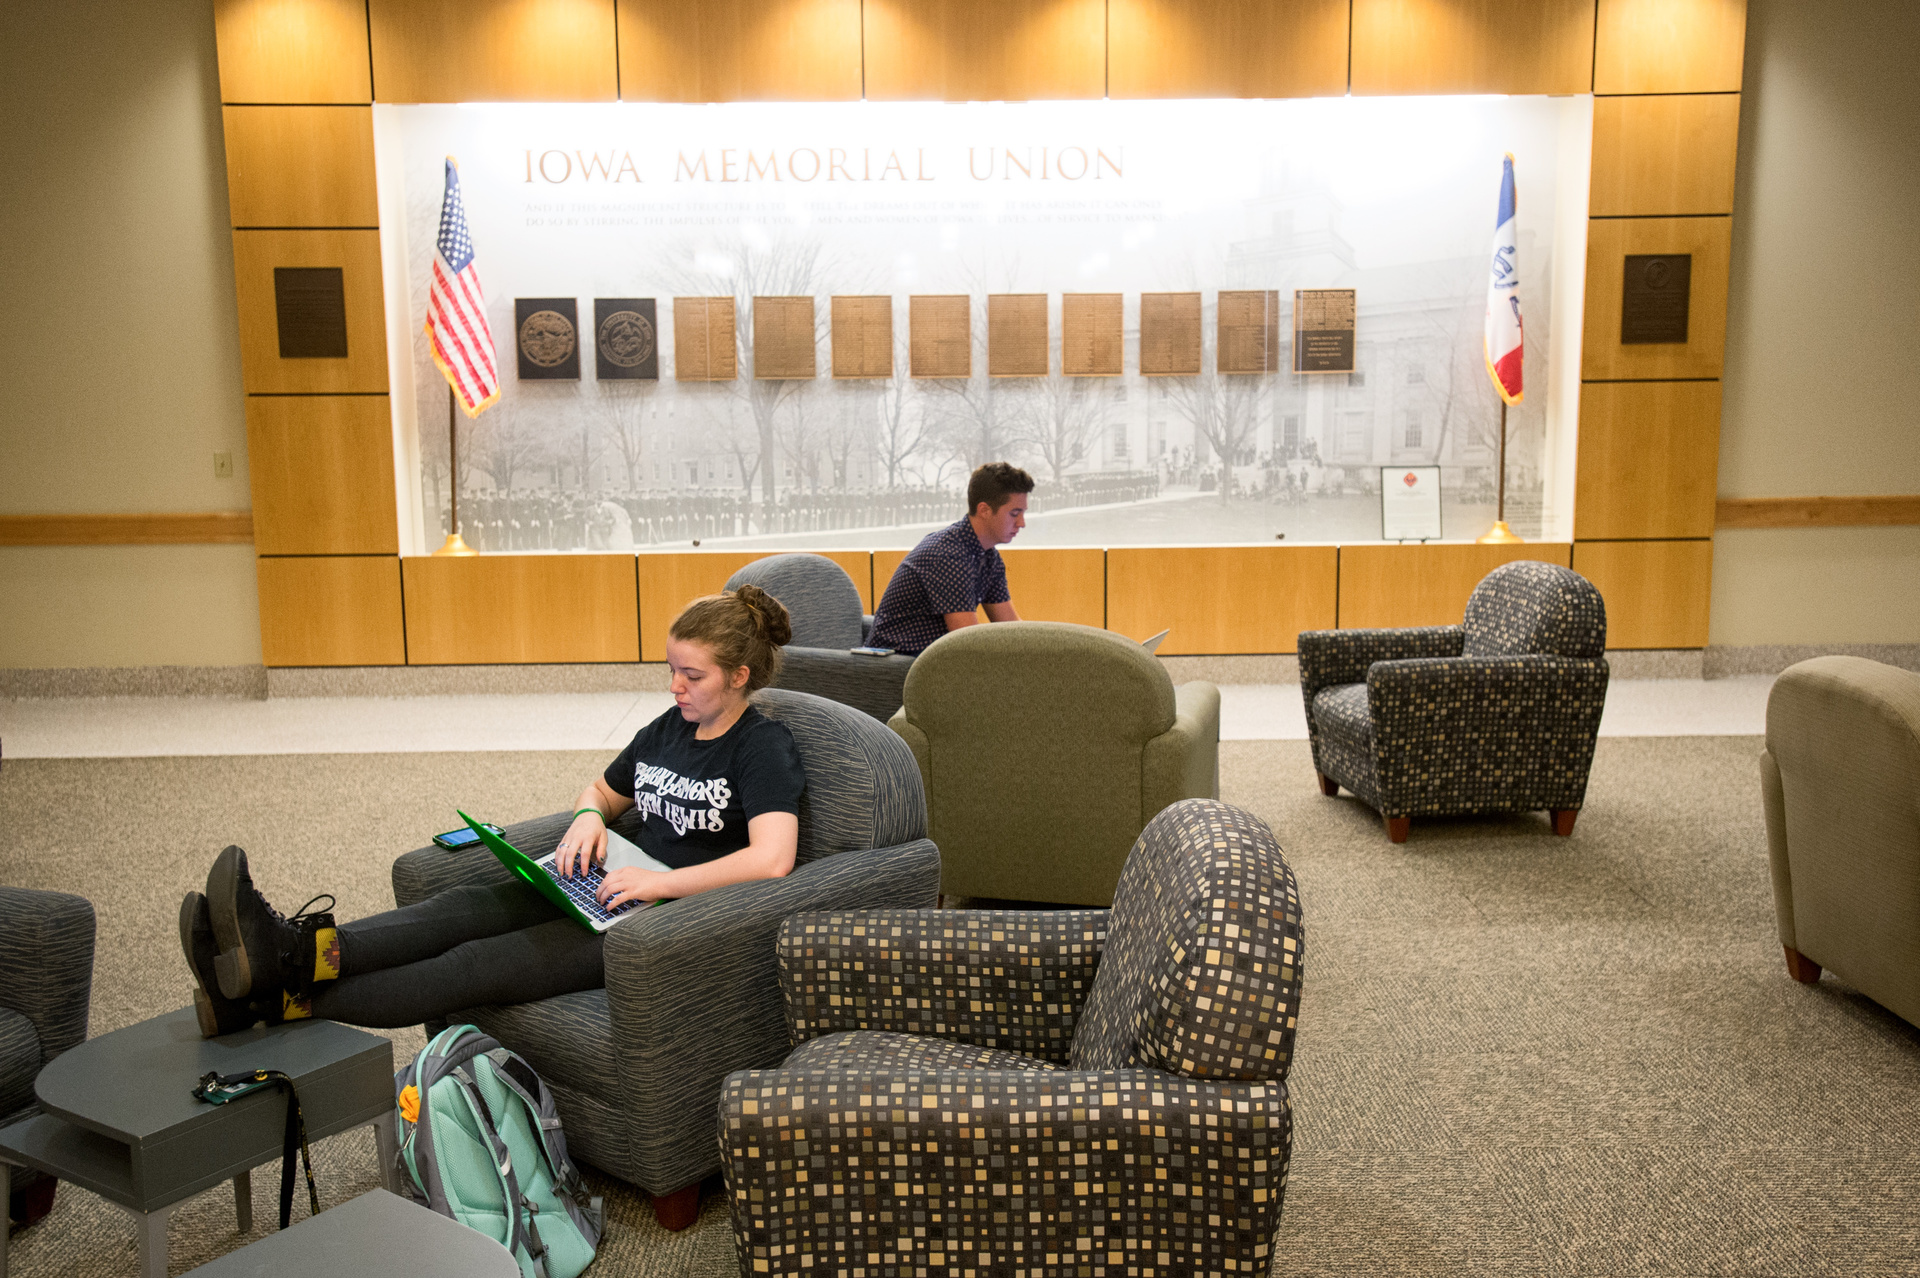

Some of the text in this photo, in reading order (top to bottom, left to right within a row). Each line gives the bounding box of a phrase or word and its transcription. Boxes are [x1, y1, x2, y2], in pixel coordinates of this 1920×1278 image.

[523, 145, 1125, 184] IOWA MEMORIAL UNION
[525, 217, 545, 226] DO
[547, 217, 564, 226] SO
[566, 217, 580, 226] BY
[583, 217, 640, 226] STIRRING
[643, 216, 665, 225] THE
[668, 216, 724, 225] IMPULSES
[817, 215, 843, 224] MEN
[846, 215, 873, 224] AND
[875, 215, 921, 224] WOMEN
[1124, 213, 1177, 222] MANKI
[570, 202, 598, 212] THIS
[600, 202, 681, 212] MAGNIFICENT
[685, 202, 751, 211] STRUCTURE
[863, 201, 911, 211] DREAMS
[635, 791, 725, 837] YAN LEWIS
